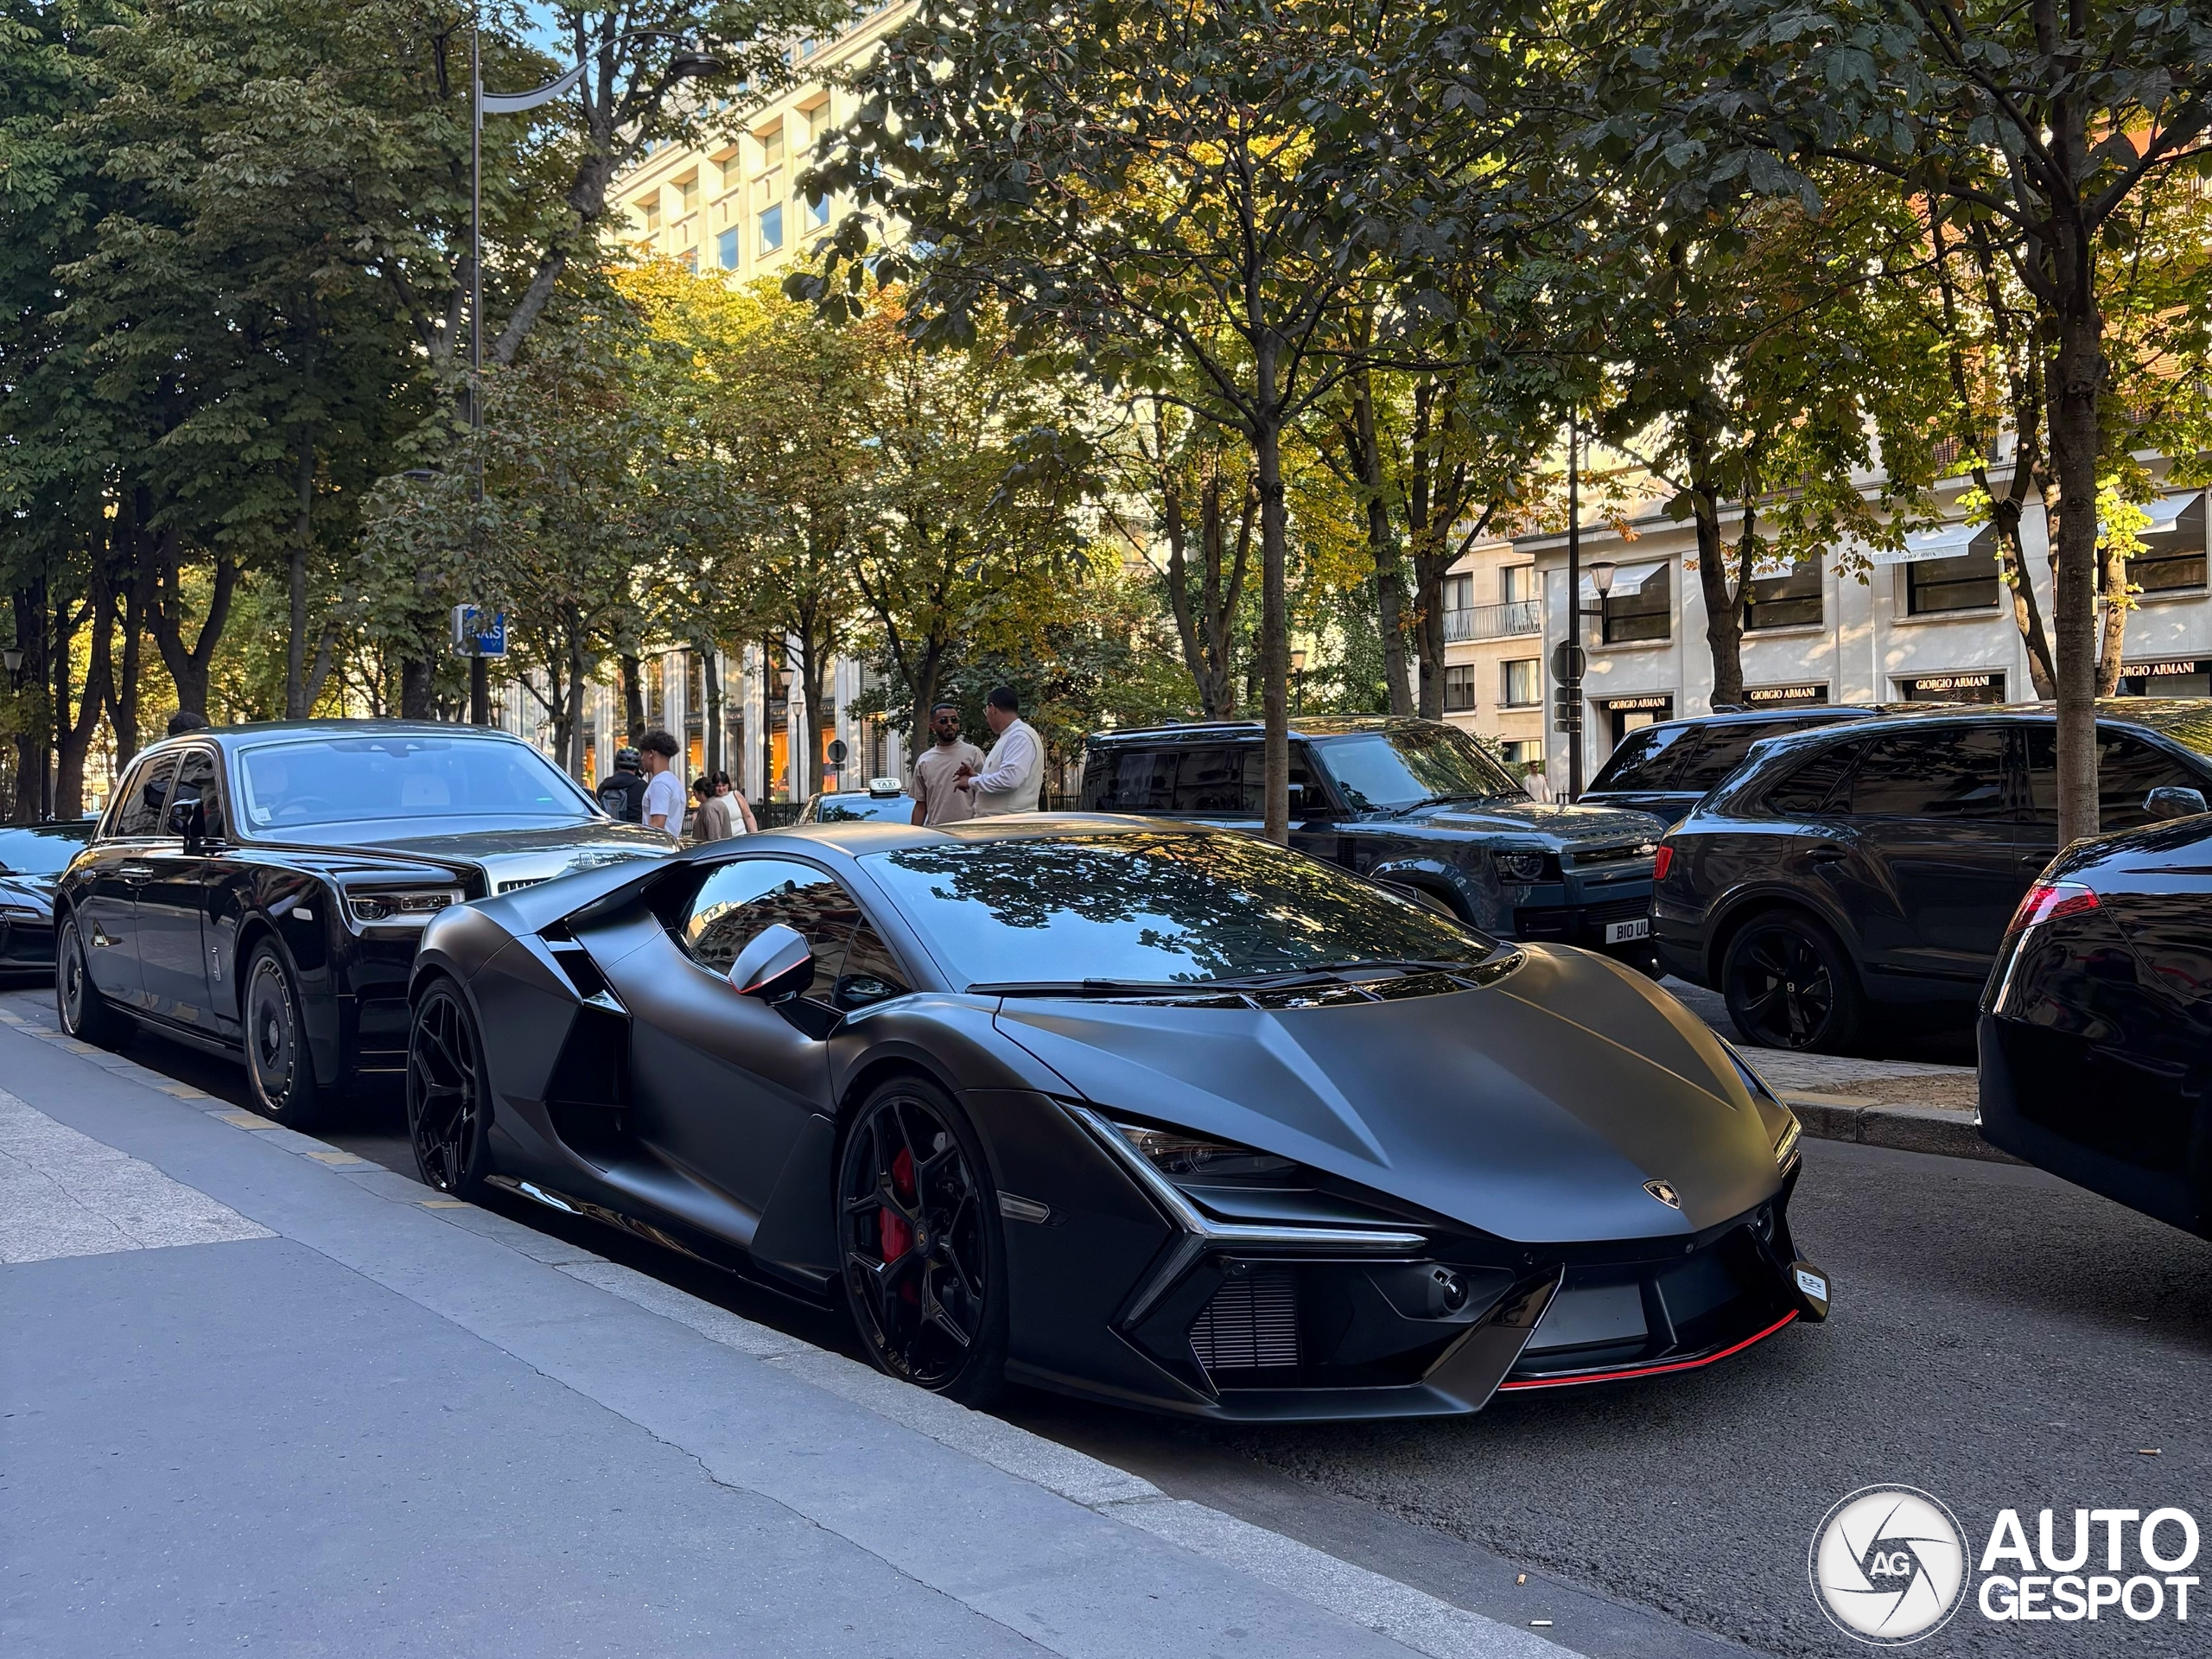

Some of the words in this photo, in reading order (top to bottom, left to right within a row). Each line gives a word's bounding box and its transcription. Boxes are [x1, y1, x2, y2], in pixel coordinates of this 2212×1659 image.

[2120, 664, 2151, 677] ORGIO
[2152, 662, 2195, 675] ARMANI
[1916, 678, 1953, 690] GIORGIO
[1954, 676, 1990, 688] ARMANI
[1751, 690, 1783, 701] GIORGIO
[1783, 687, 1815, 698] ARMANI
[1609, 699, 1637, 709] GIORGIO
[1637, 696, 1666, 708] ARMANI
